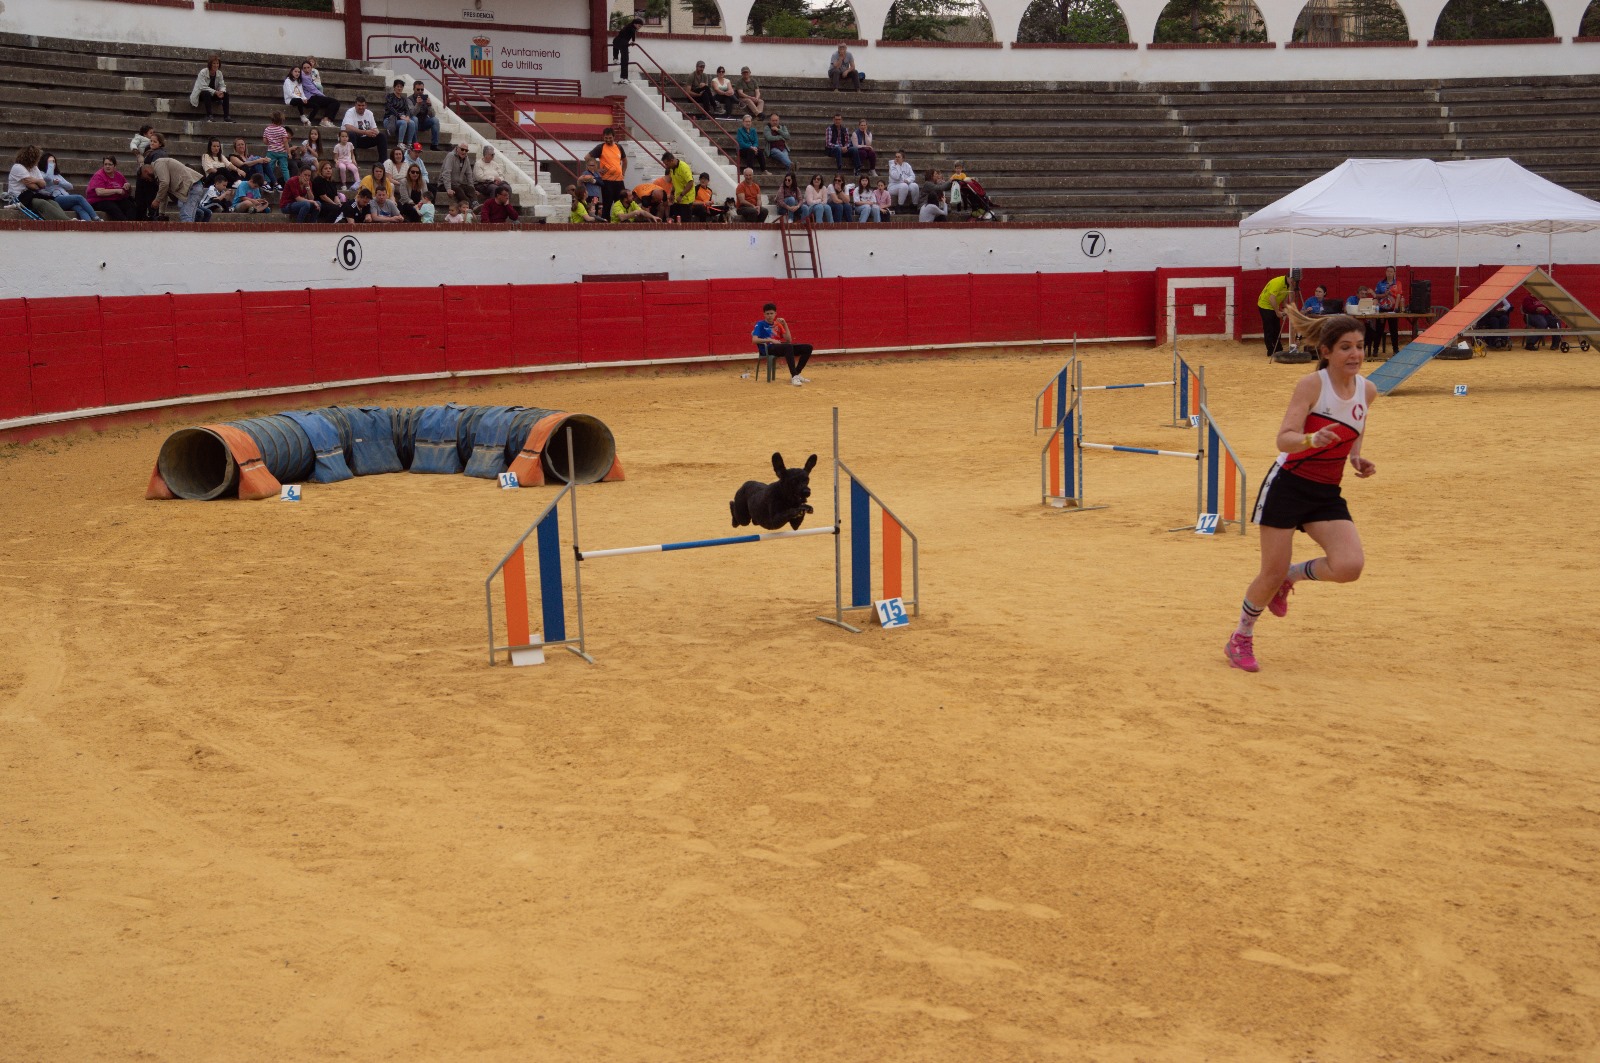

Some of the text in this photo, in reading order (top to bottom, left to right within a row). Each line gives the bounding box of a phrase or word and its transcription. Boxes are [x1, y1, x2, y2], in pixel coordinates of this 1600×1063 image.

[394, 36, 441, 54] utrillas
[500, 46, 561, 59] Ayuntamiento
[419, 54, 467, 70] motiva
[501, 60, 543, 70] de Utrillas
[1087, 234, 1100, 255] 7
[343, 239, 356, 267] 6
[502, 472, 516, 486] 16
[287, 485, 295, 498] 6
[1200, 514, 1218, 530] 17
[880, 598, 902, 622] 15
